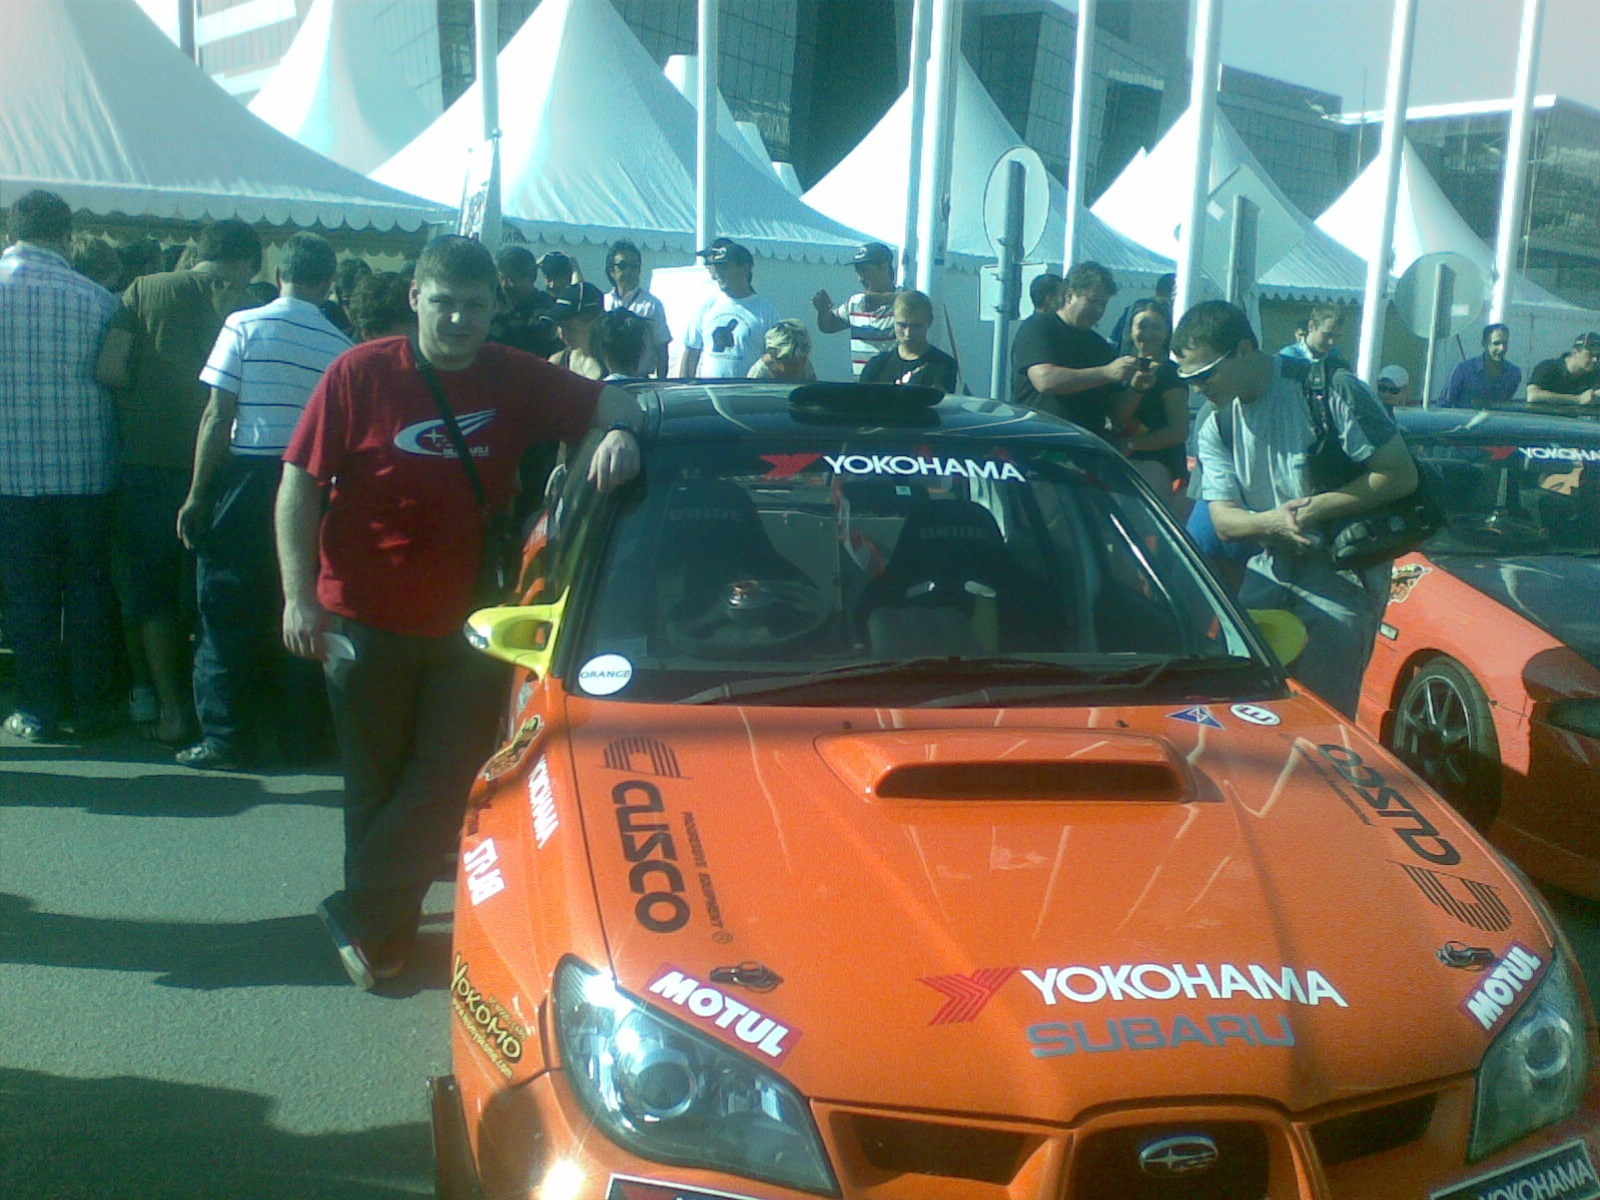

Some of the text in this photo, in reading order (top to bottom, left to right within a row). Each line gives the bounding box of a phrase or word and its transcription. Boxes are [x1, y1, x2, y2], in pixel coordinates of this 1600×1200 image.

[823, 455, 1026, 482] YOKOHAMA
[580, 669, 631, 679] ORANGE
[1317, 744, 1462, 866] CUSCO
[611, 779, 691, 934] CUSCO
[450, 954, 523, 1062] YOKOMO
[648, 970, 790, 1058] MOTUL
[1021, 964, 1349, 1008] YOKOHAMA
[1466, 946, 1542, 1031] MOTUL
[1026, 1013, 1297, 1059] SUBARU
